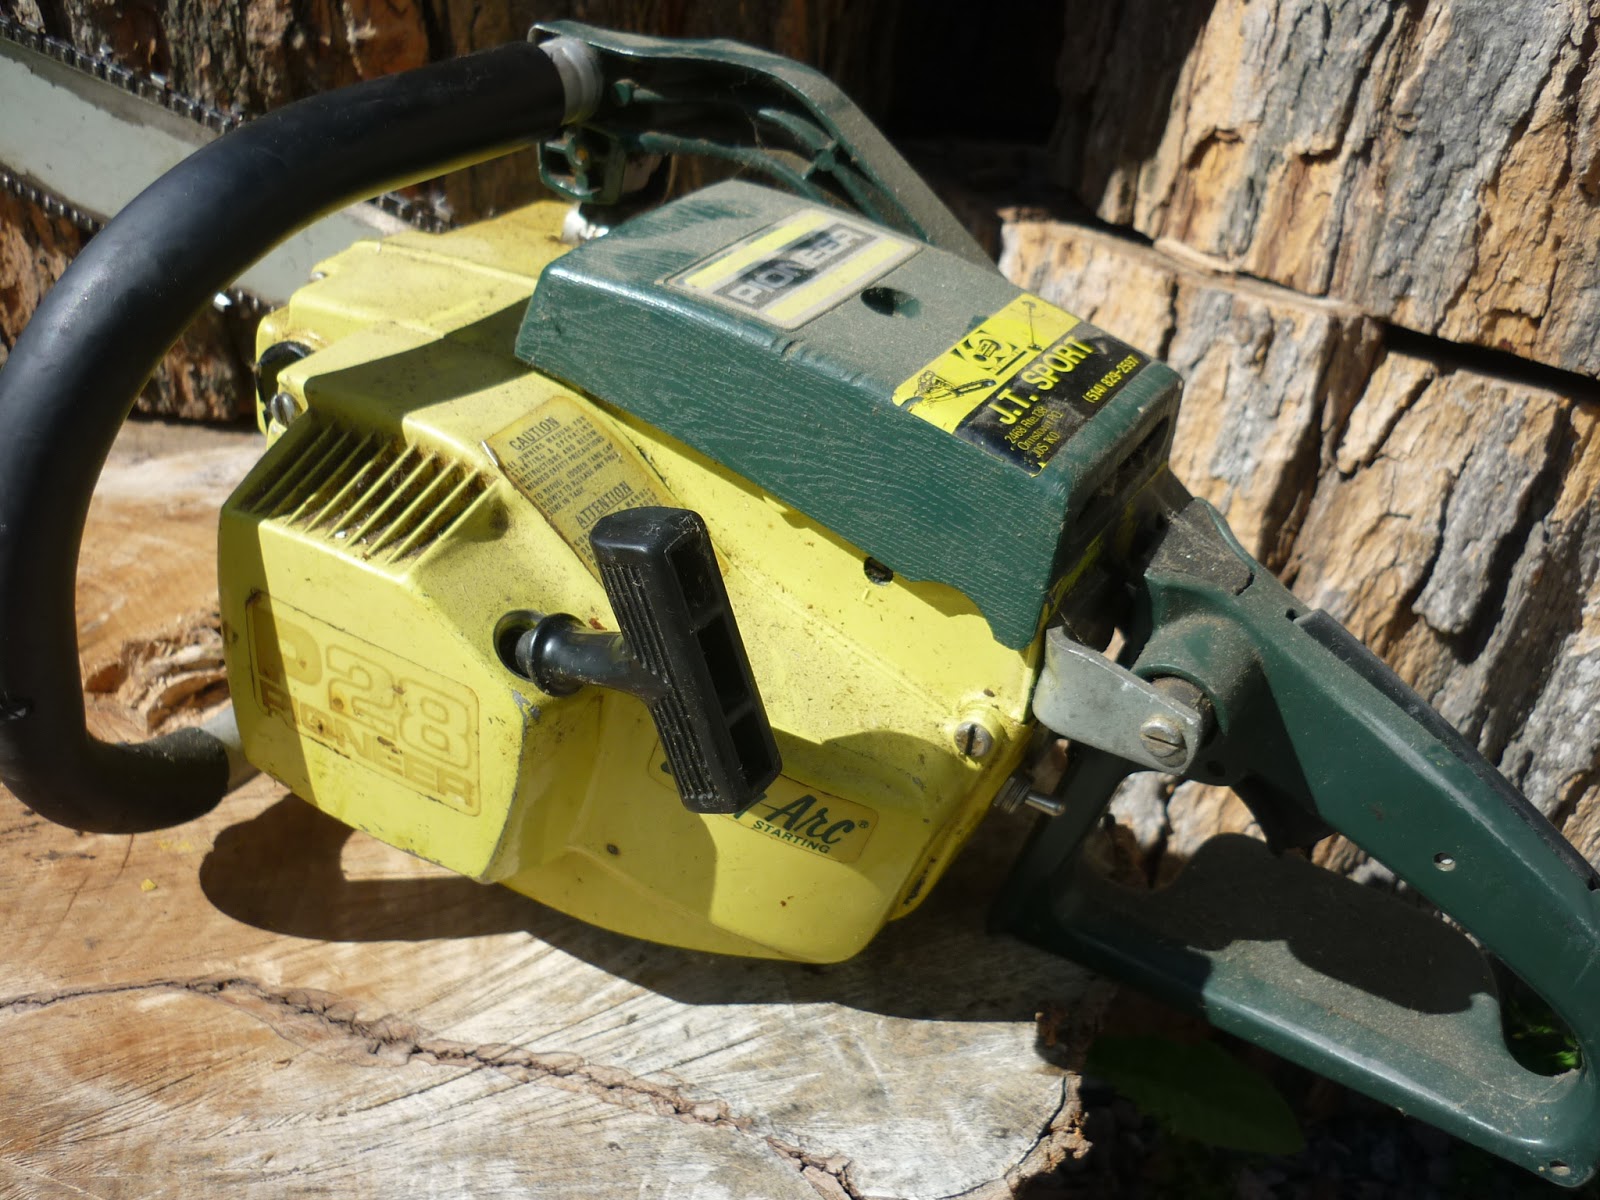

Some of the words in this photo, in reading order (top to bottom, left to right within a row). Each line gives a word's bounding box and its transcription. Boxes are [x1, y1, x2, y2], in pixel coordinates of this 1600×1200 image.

[727, 229, 861, 305] PIONEER
[1021, 335, 1094, 390] SPORT
[1101, 353, 1139, 387] 829-2597
[509, 417, 560, 450] CAUTION
[562, 443, 576, 455] AND
[563, 483, 572, 492] TO
[575, 481, 633, 529] ATTENTION
[260, 679, 472, 807] PIONEER
[753, 820, 830, 853] STARTING
